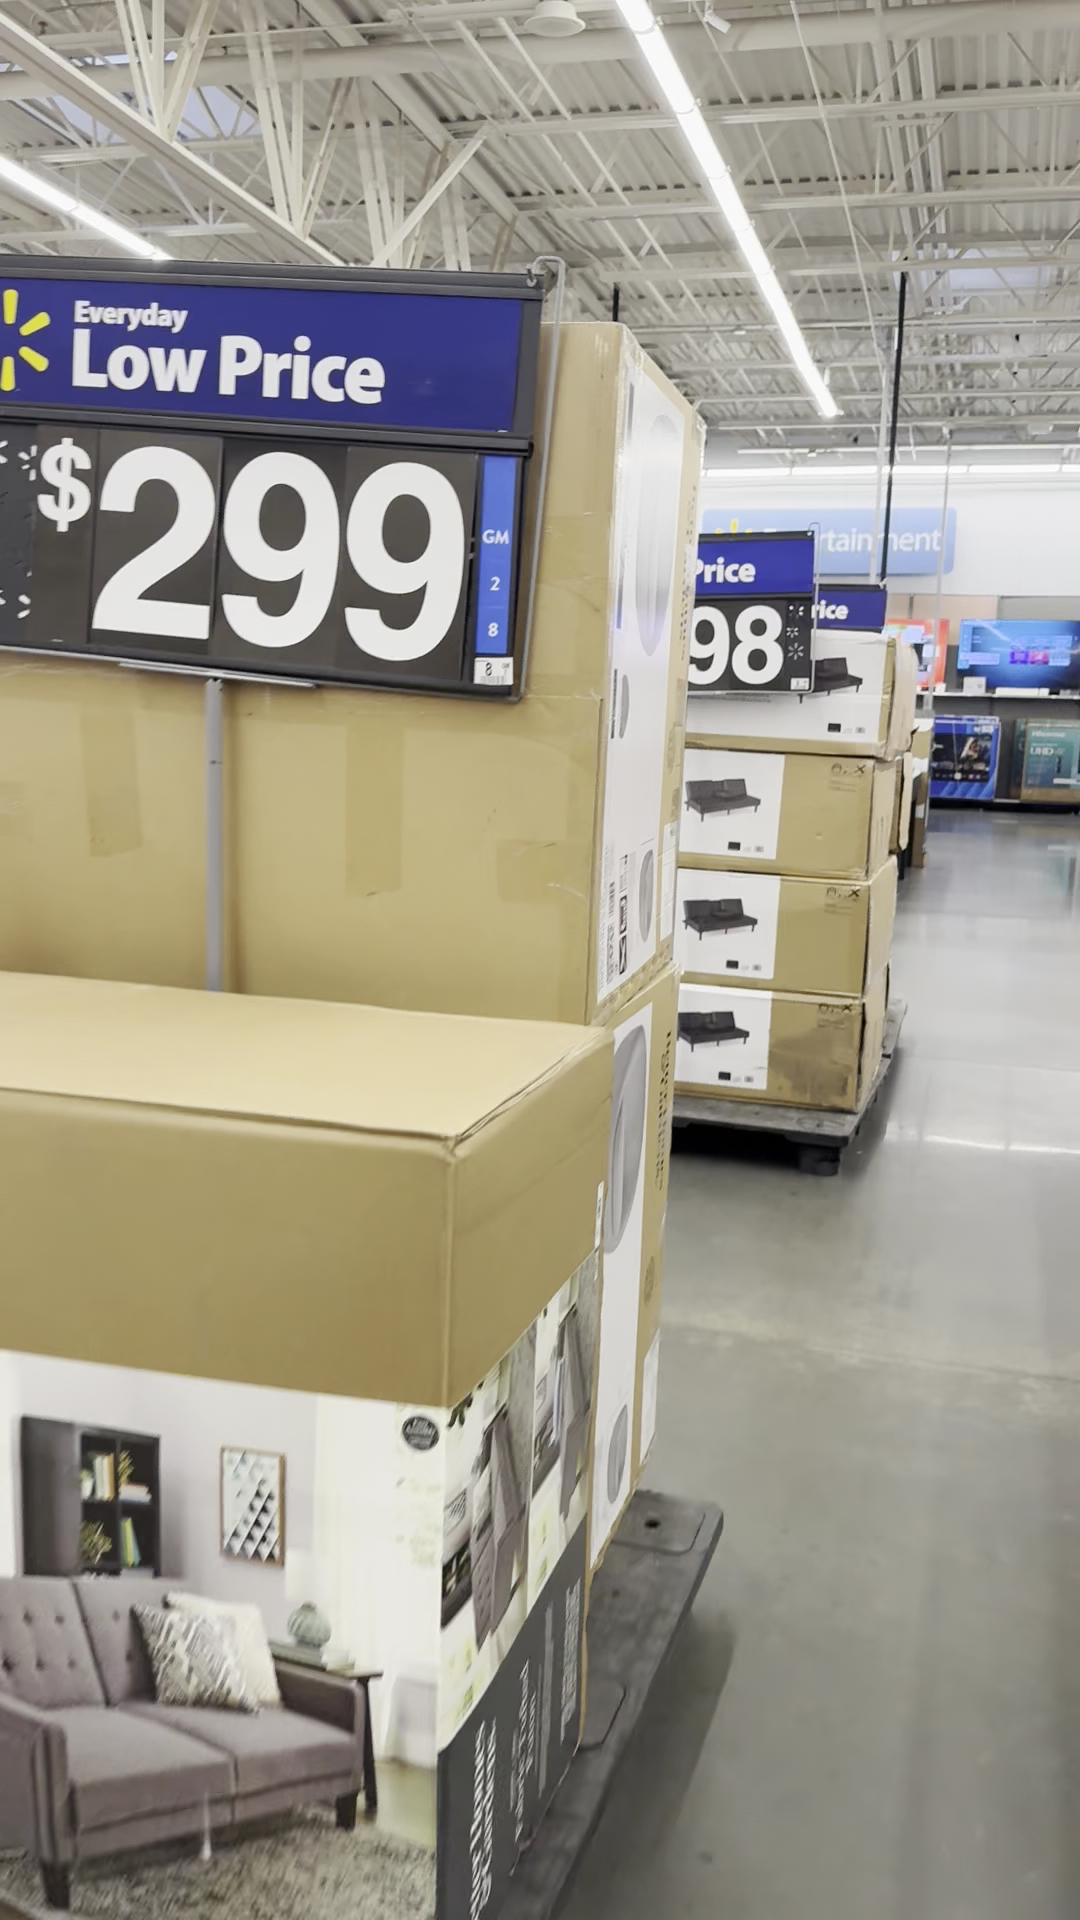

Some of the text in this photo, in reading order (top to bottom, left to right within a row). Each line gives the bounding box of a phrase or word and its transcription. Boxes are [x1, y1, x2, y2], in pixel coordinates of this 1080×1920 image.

[74, 300, 188, 333] Everyday
[72, 329, 386, 404] Low Price
[481, 529, 510, 545] GM
[489, 576, 501, 592] 2
[811, 599, 849, 620] rice
[487, 622, 500, 638] 8
[688, 604, 784, 686] 98
[485, 661, 493, 677] 8
